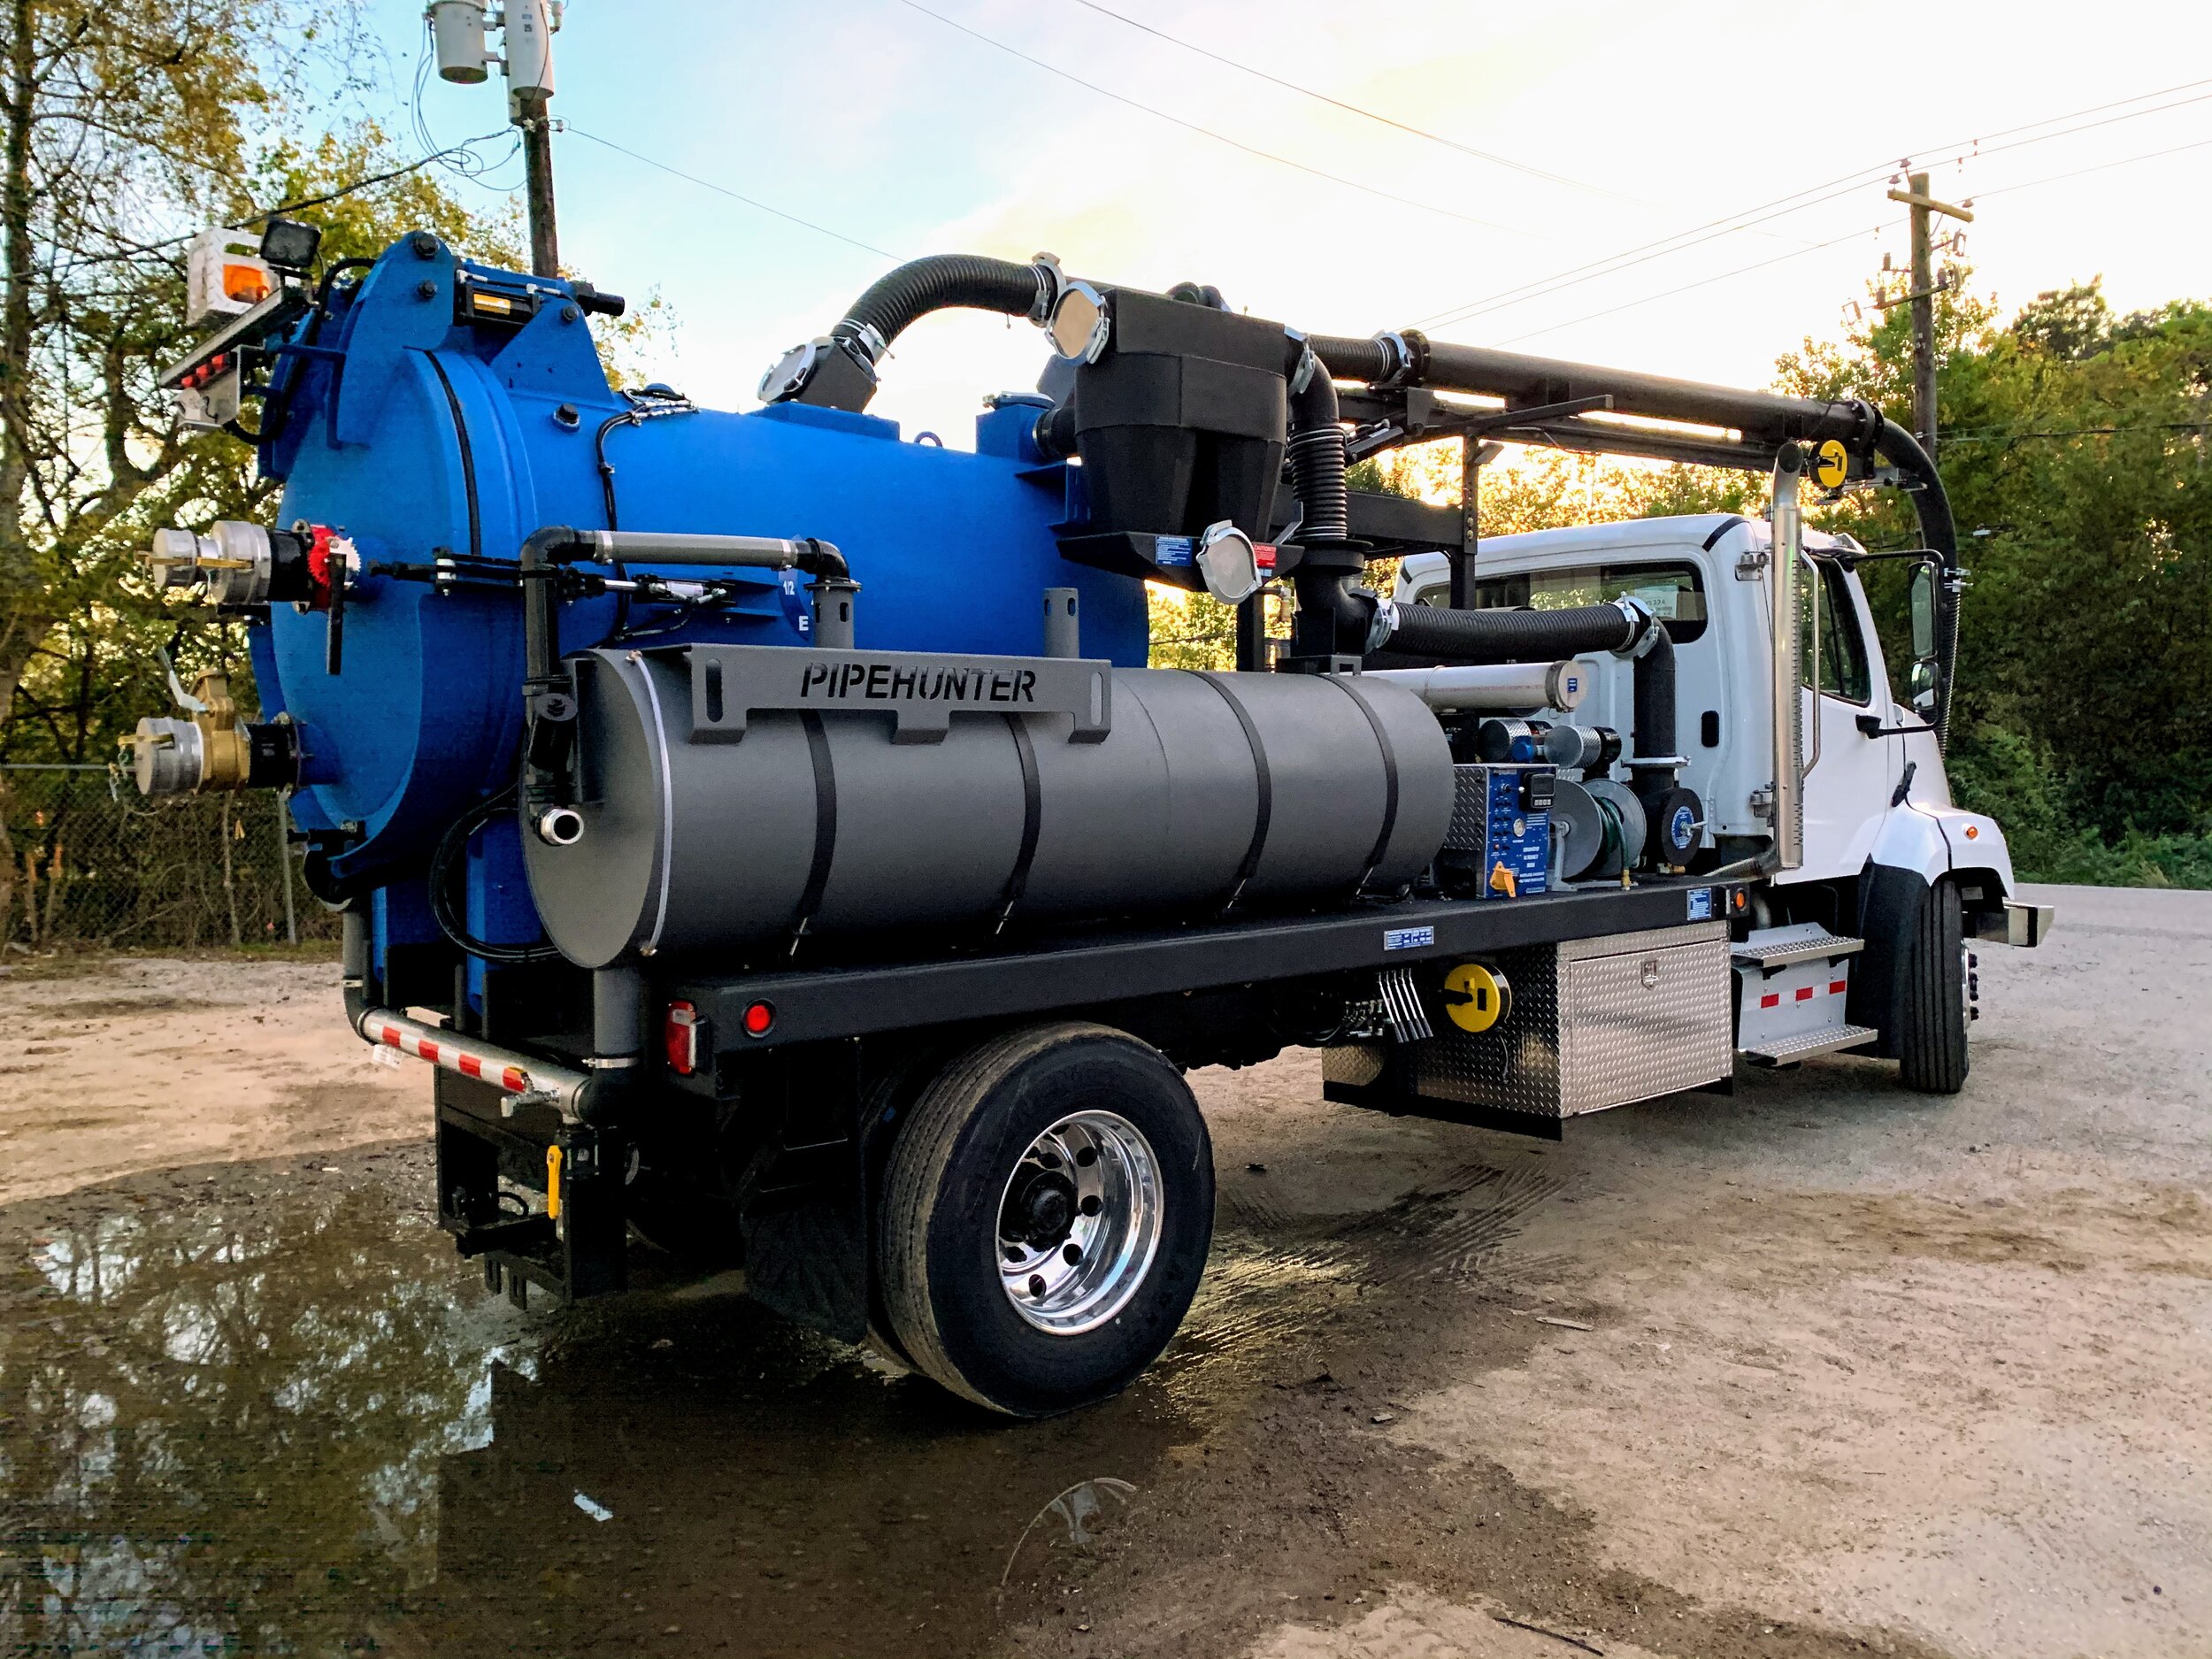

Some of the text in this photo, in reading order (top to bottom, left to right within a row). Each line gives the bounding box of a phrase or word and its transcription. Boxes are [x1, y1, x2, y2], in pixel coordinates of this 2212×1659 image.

[783, 580, 795, 595] 1/2
[798, 615, 809, 631] E
[800, 662, 1036, 703] PIPEHUNTER
